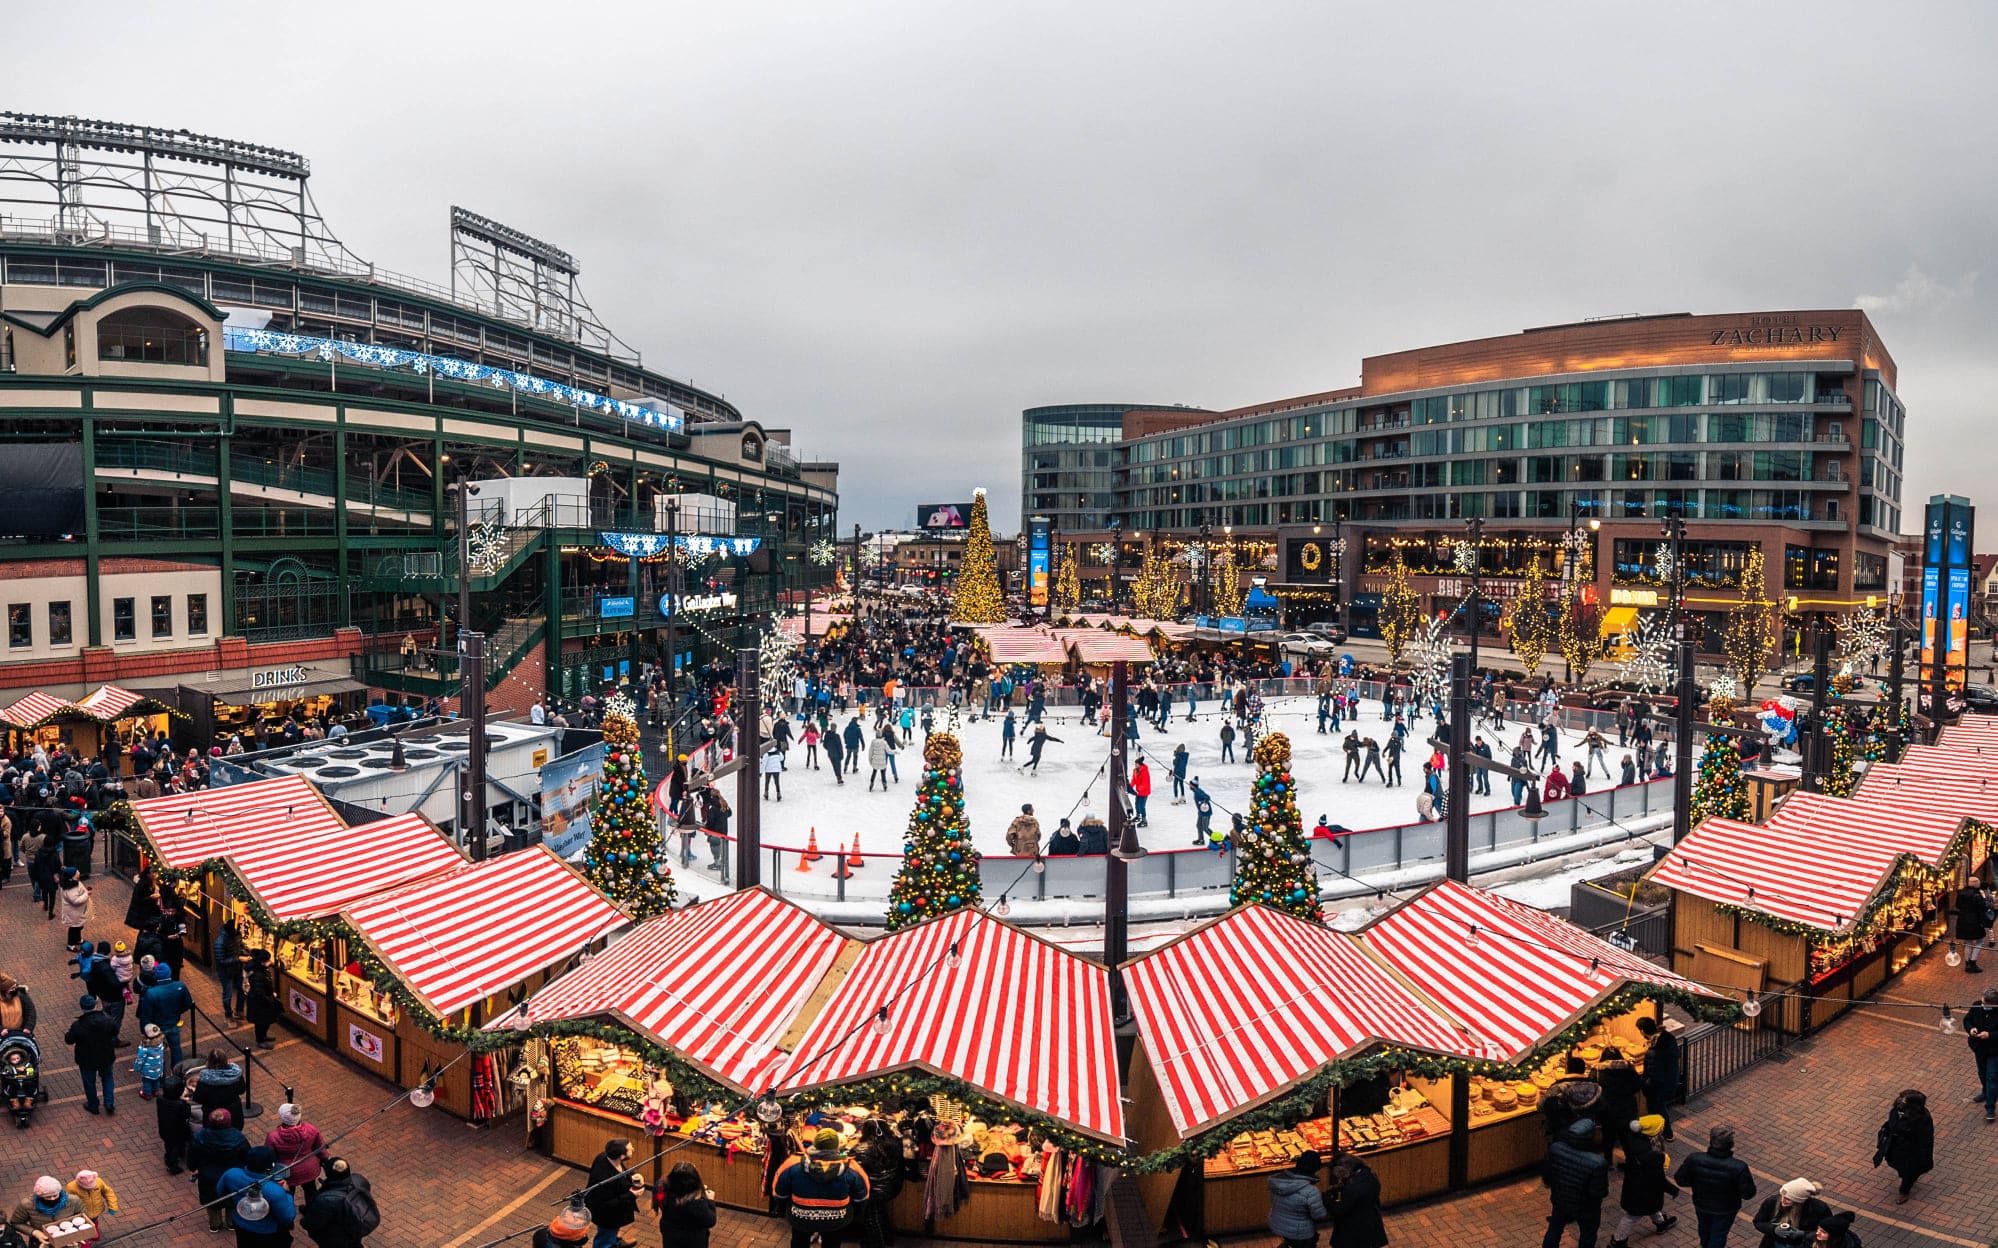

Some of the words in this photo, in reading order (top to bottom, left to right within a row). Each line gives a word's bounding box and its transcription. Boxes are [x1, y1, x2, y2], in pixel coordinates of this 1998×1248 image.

[1711, 326, 1844, 346] ZACHARY
[682, 594, 721, 613] Gallagher
[252, 667, 307, 688] DRINKS
